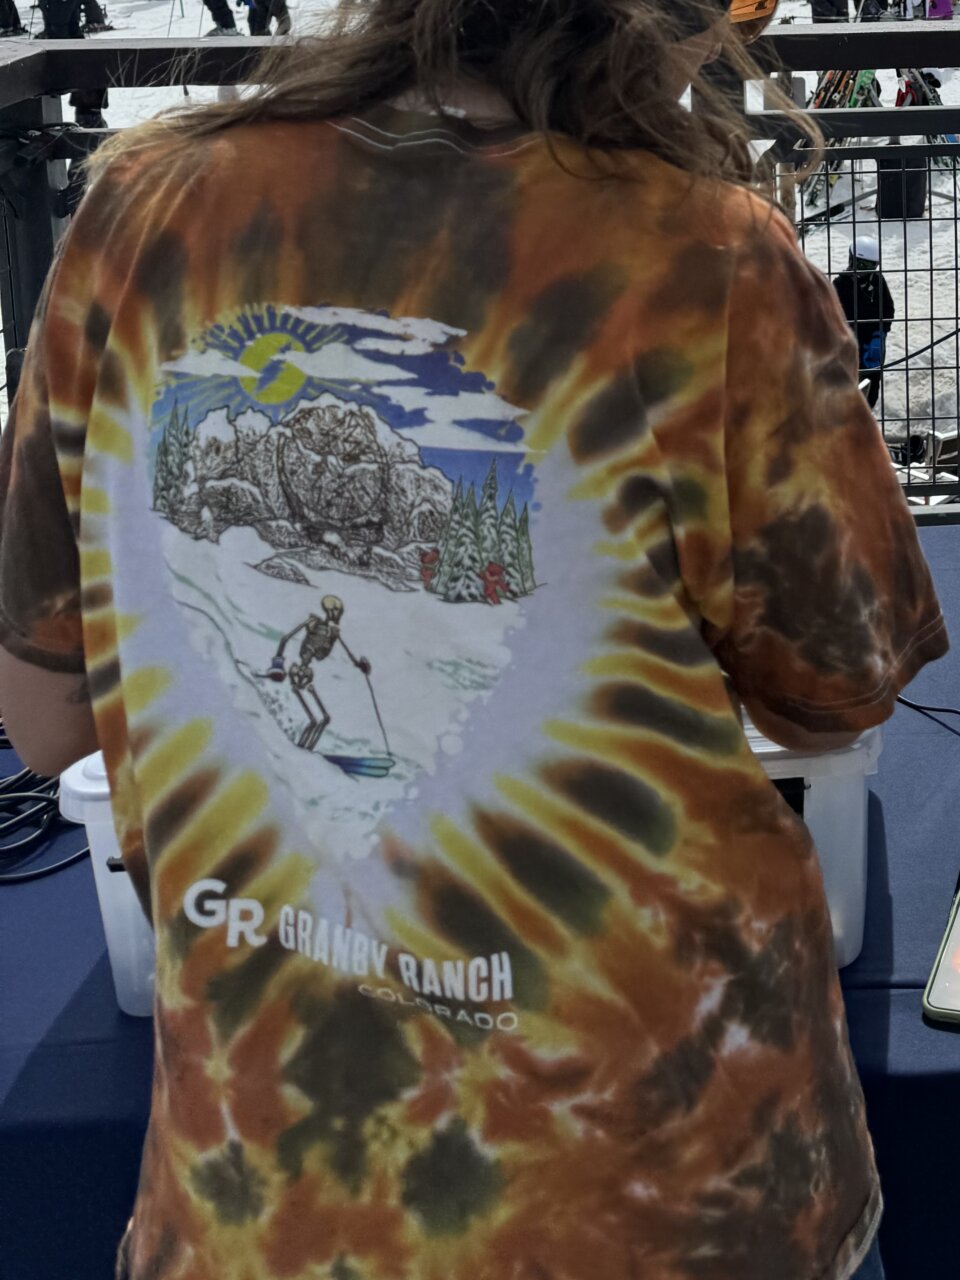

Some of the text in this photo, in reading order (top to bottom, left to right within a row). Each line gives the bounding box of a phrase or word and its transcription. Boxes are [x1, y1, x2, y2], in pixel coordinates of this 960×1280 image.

[183, 878, 268, 949] GR
[279, 904, 513, 1002] GRANBY RANCH
[358, 983, 518, 1031] COLORADO
